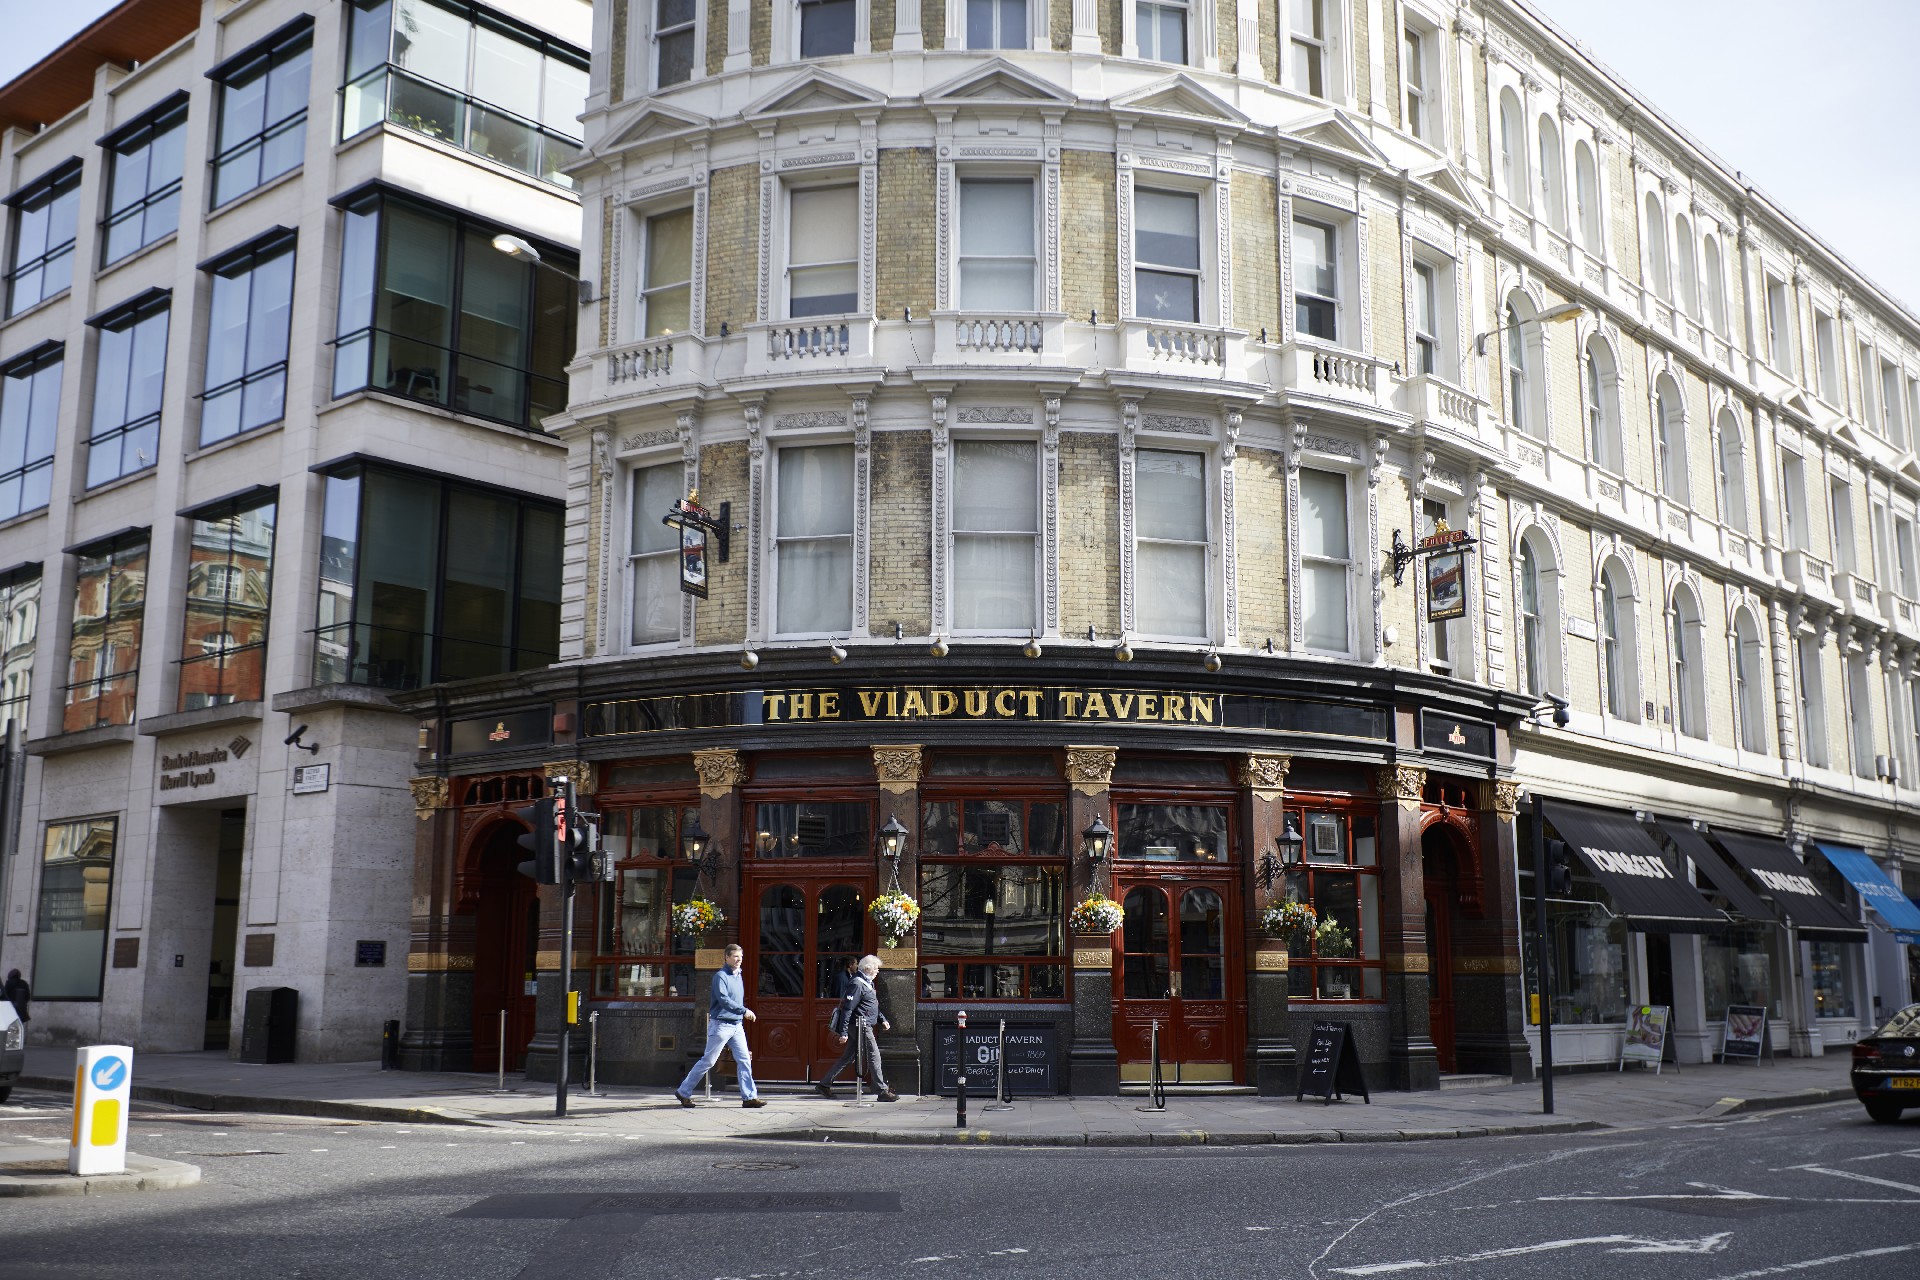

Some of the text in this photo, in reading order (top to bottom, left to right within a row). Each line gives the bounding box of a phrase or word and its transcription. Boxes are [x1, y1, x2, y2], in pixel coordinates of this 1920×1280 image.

[762, 690, 1215, 723] THE VIADUCT TAVERN
[161, 748, 228, 771] Bank of America
[160, 768, 216, 791] Merrill Lynch
[1580, 846, 1675, 880] TONI&GUY
[1750, 867, 1822, 897] TONI&GUY
[965, 1035, 998, 1044] IADUCT
